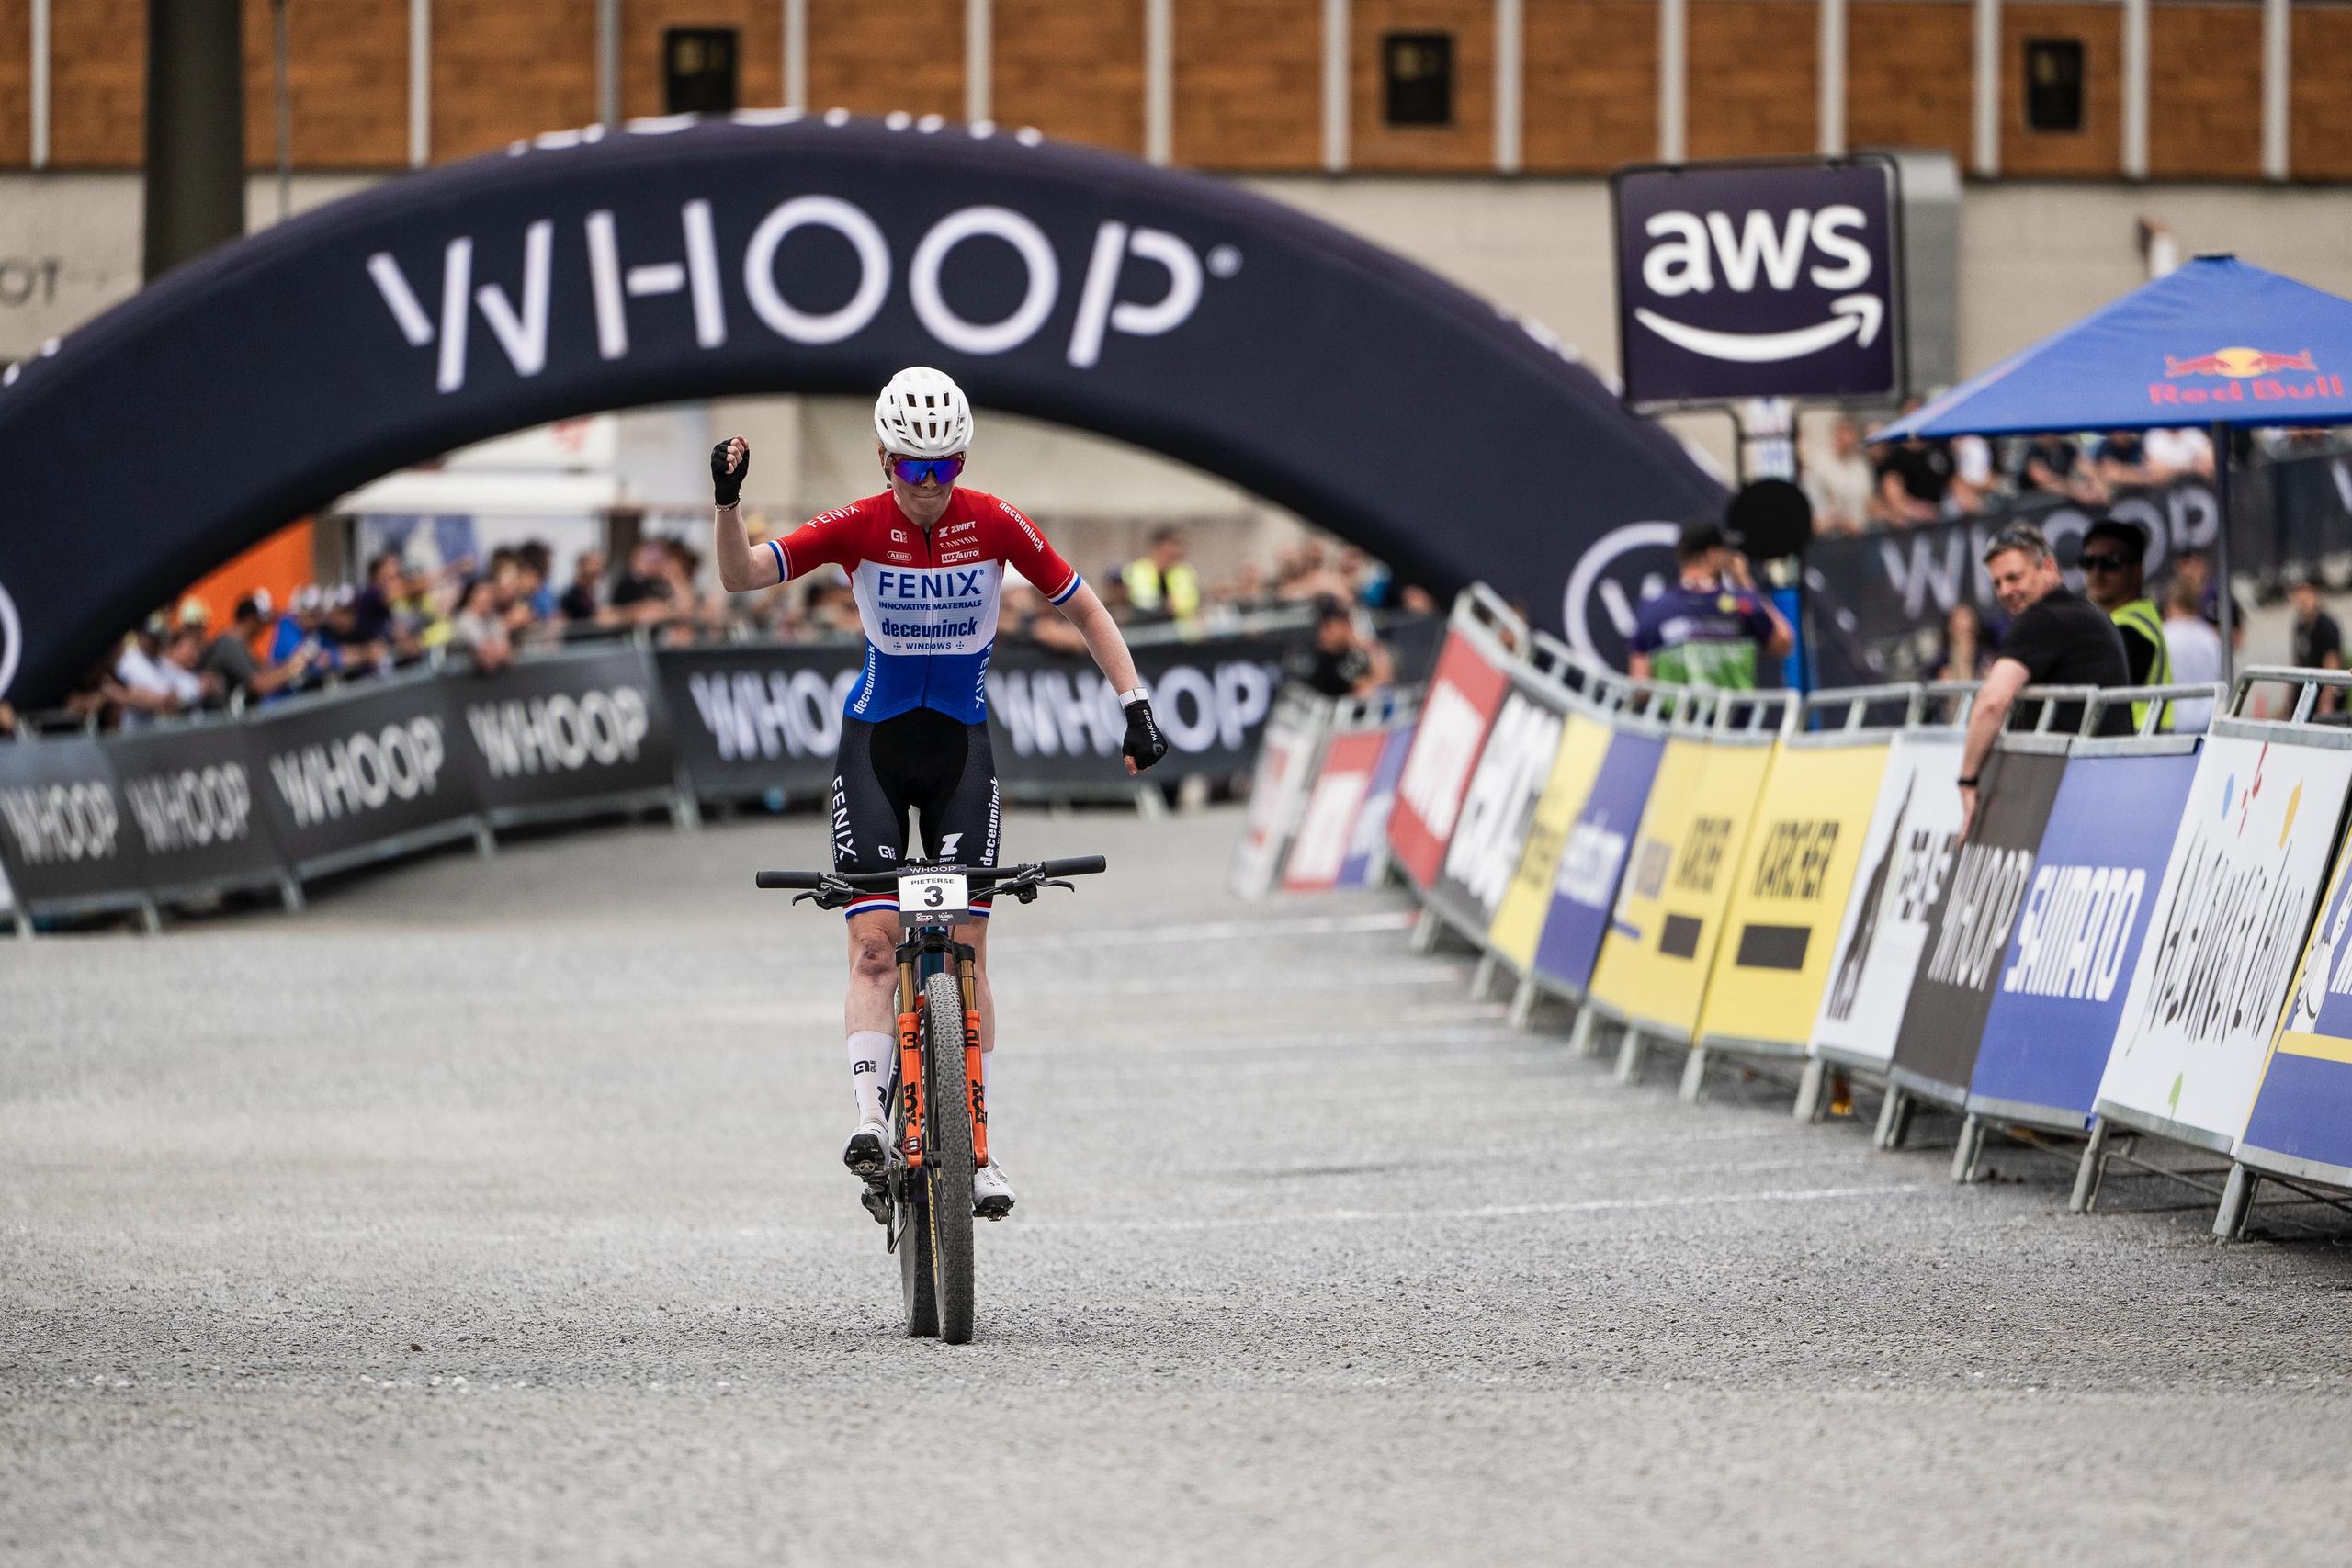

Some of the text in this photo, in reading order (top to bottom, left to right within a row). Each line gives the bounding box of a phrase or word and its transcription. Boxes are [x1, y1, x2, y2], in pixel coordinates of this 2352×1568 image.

[1644, 205, 1871, 296] aws
[368, 196, 1204, 393] WHOOP
[2148, 375, 2344, 405] Red Bull
[807, 505, 860, 528] FENIX
[999, 502, 1044, 552] deceuninck
[879, 600, 982, 610] INNOVATIVE MATERIALS
[882, 617, 978, 637] deceuninck
[853, 645, 876, 714] deceuninck
[466, 684, 649, 779] WHOOP
[1143, 709, 1158, 741] WHOOP
[270, 716, 444, 829] WHOOP
[125, 761, 250, 856] WHOOP
[832, 775, 857, 861] FENIX
[980, 776, 1000, 866] deceuninck
[924, 886, 944, 907] 3
[2003, 865, 2147, 1002] SHIMANO
[903, 1082, 918, 1126] FOX
